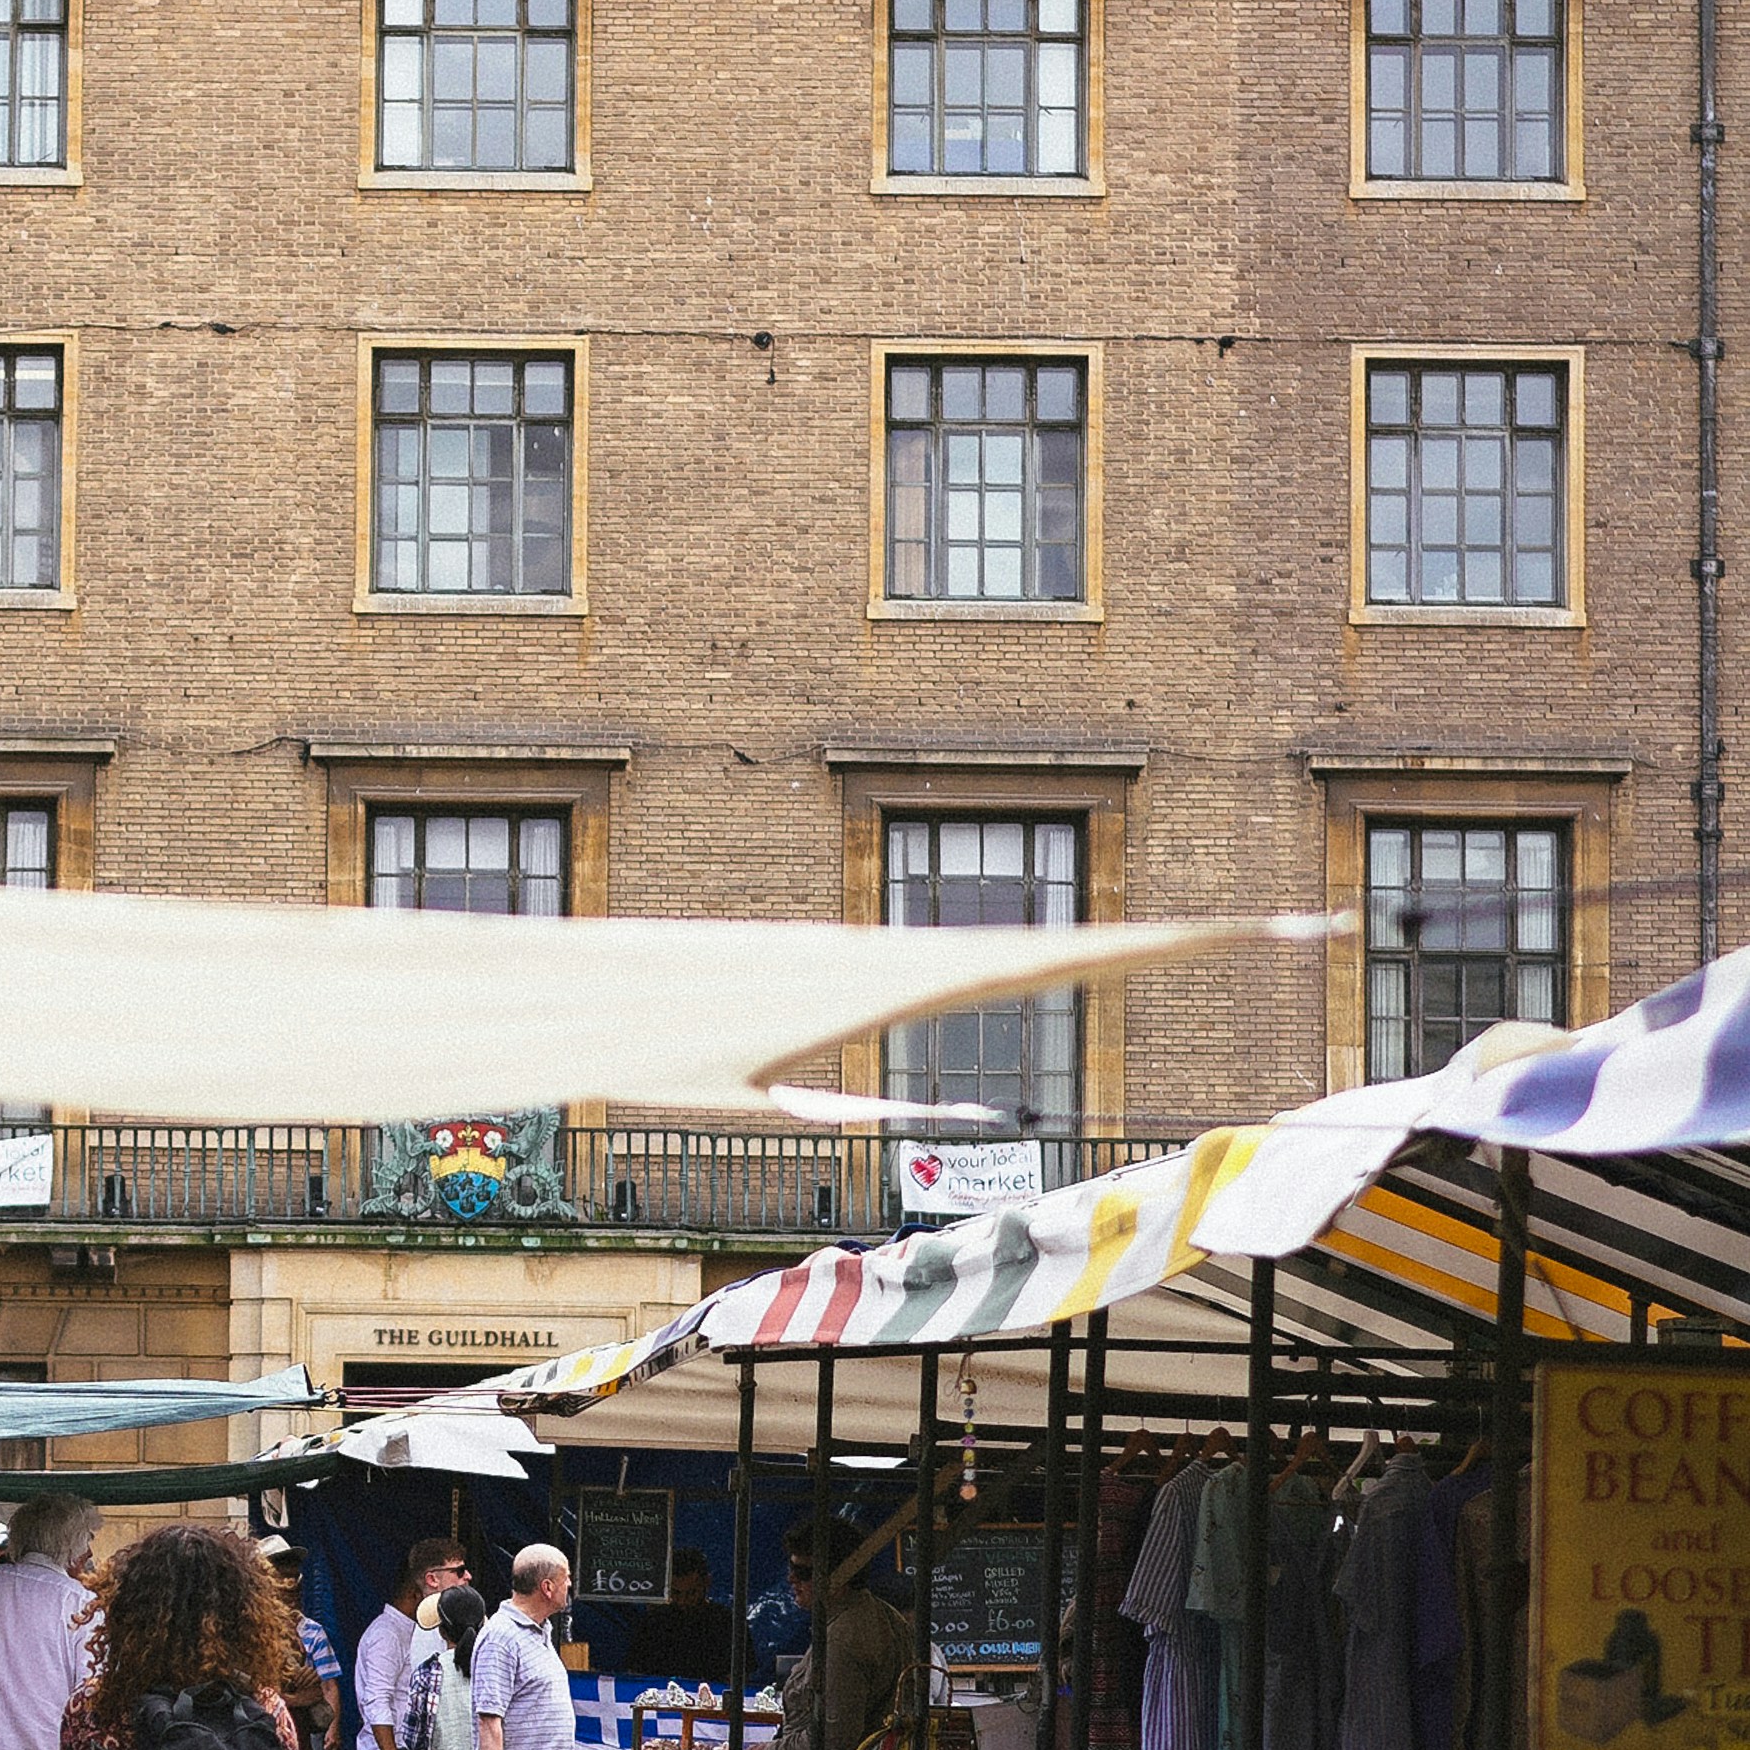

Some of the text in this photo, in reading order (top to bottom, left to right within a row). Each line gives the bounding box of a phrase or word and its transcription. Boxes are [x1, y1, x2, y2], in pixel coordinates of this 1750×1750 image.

[947, 1152, 1033, 1169] your local
[948, 1170, 1036, 1192] market
[373, 1328, 559, 1348] THE GUILDHALL
[1651, 1522, 1720, 1553] and
